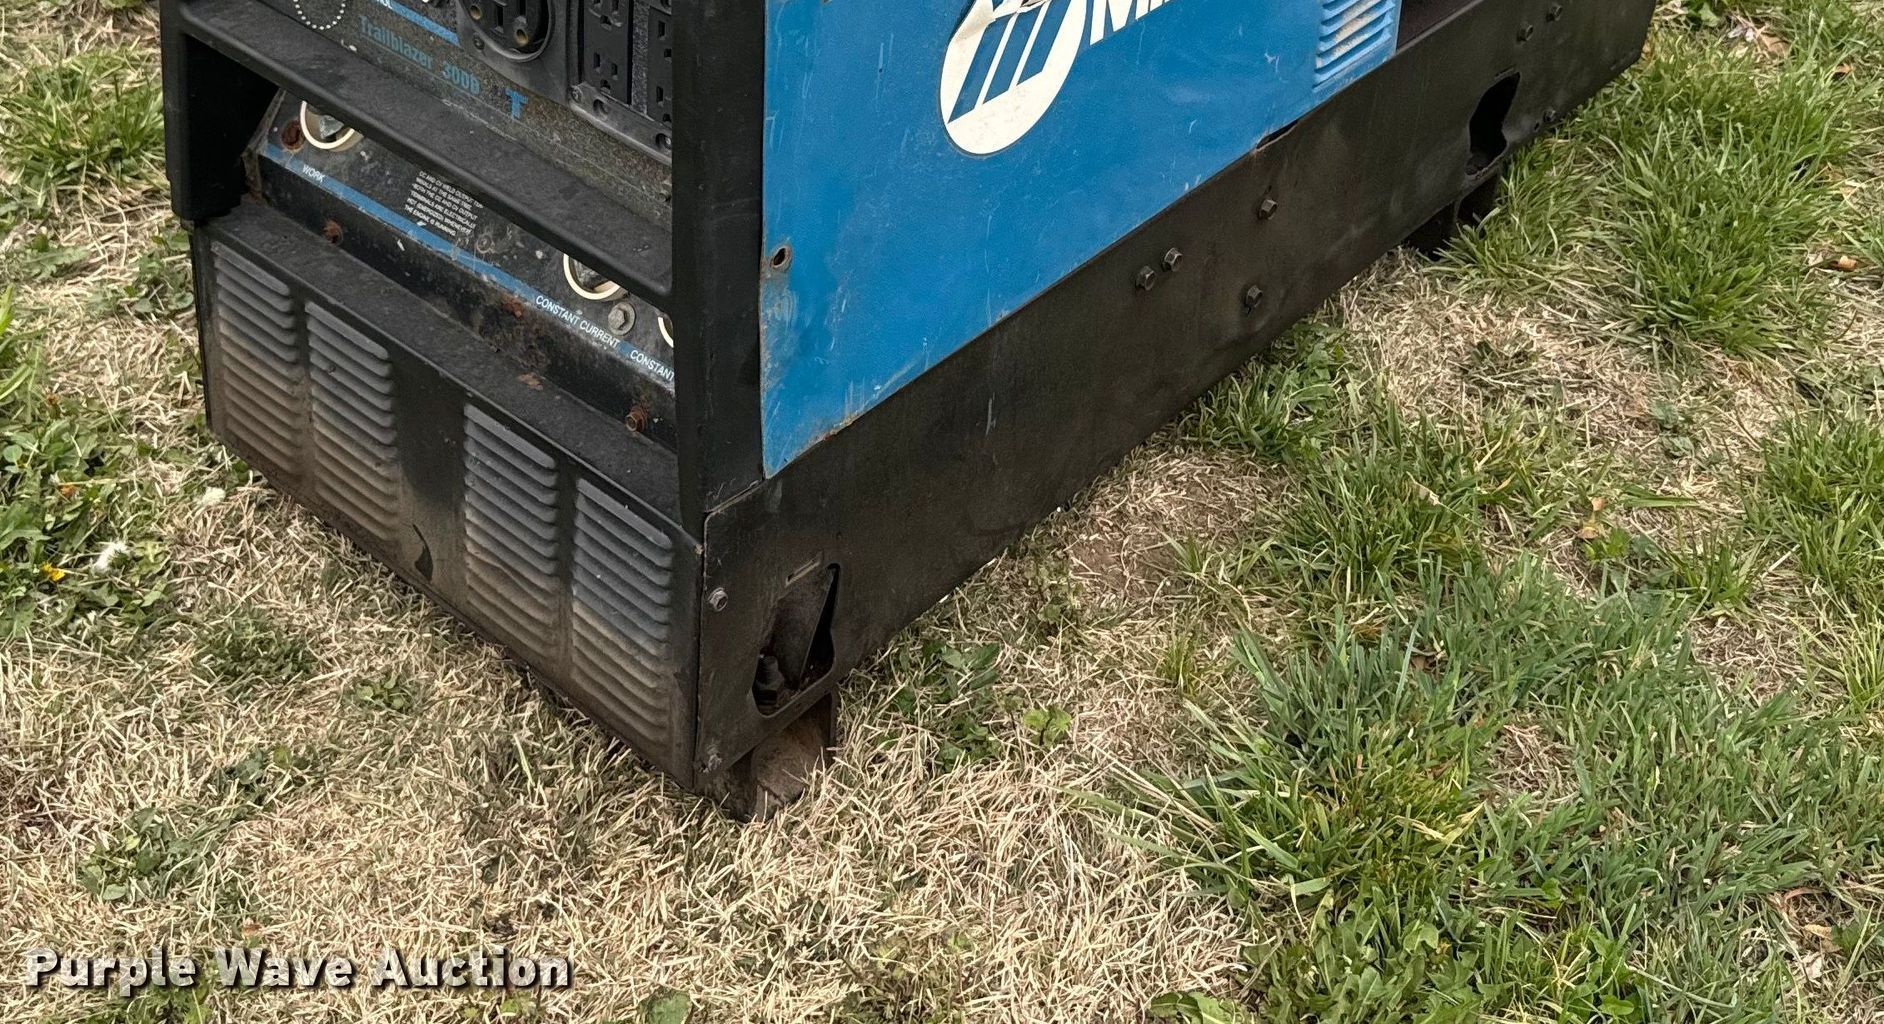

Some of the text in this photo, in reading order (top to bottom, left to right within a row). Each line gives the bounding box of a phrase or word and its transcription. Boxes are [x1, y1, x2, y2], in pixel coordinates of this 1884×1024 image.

[359, 14, 435, 71] Trailblazer
[302, 164, 325, 183] WORK
[535, 295, 620, 349] CONSTANT CURRENT
